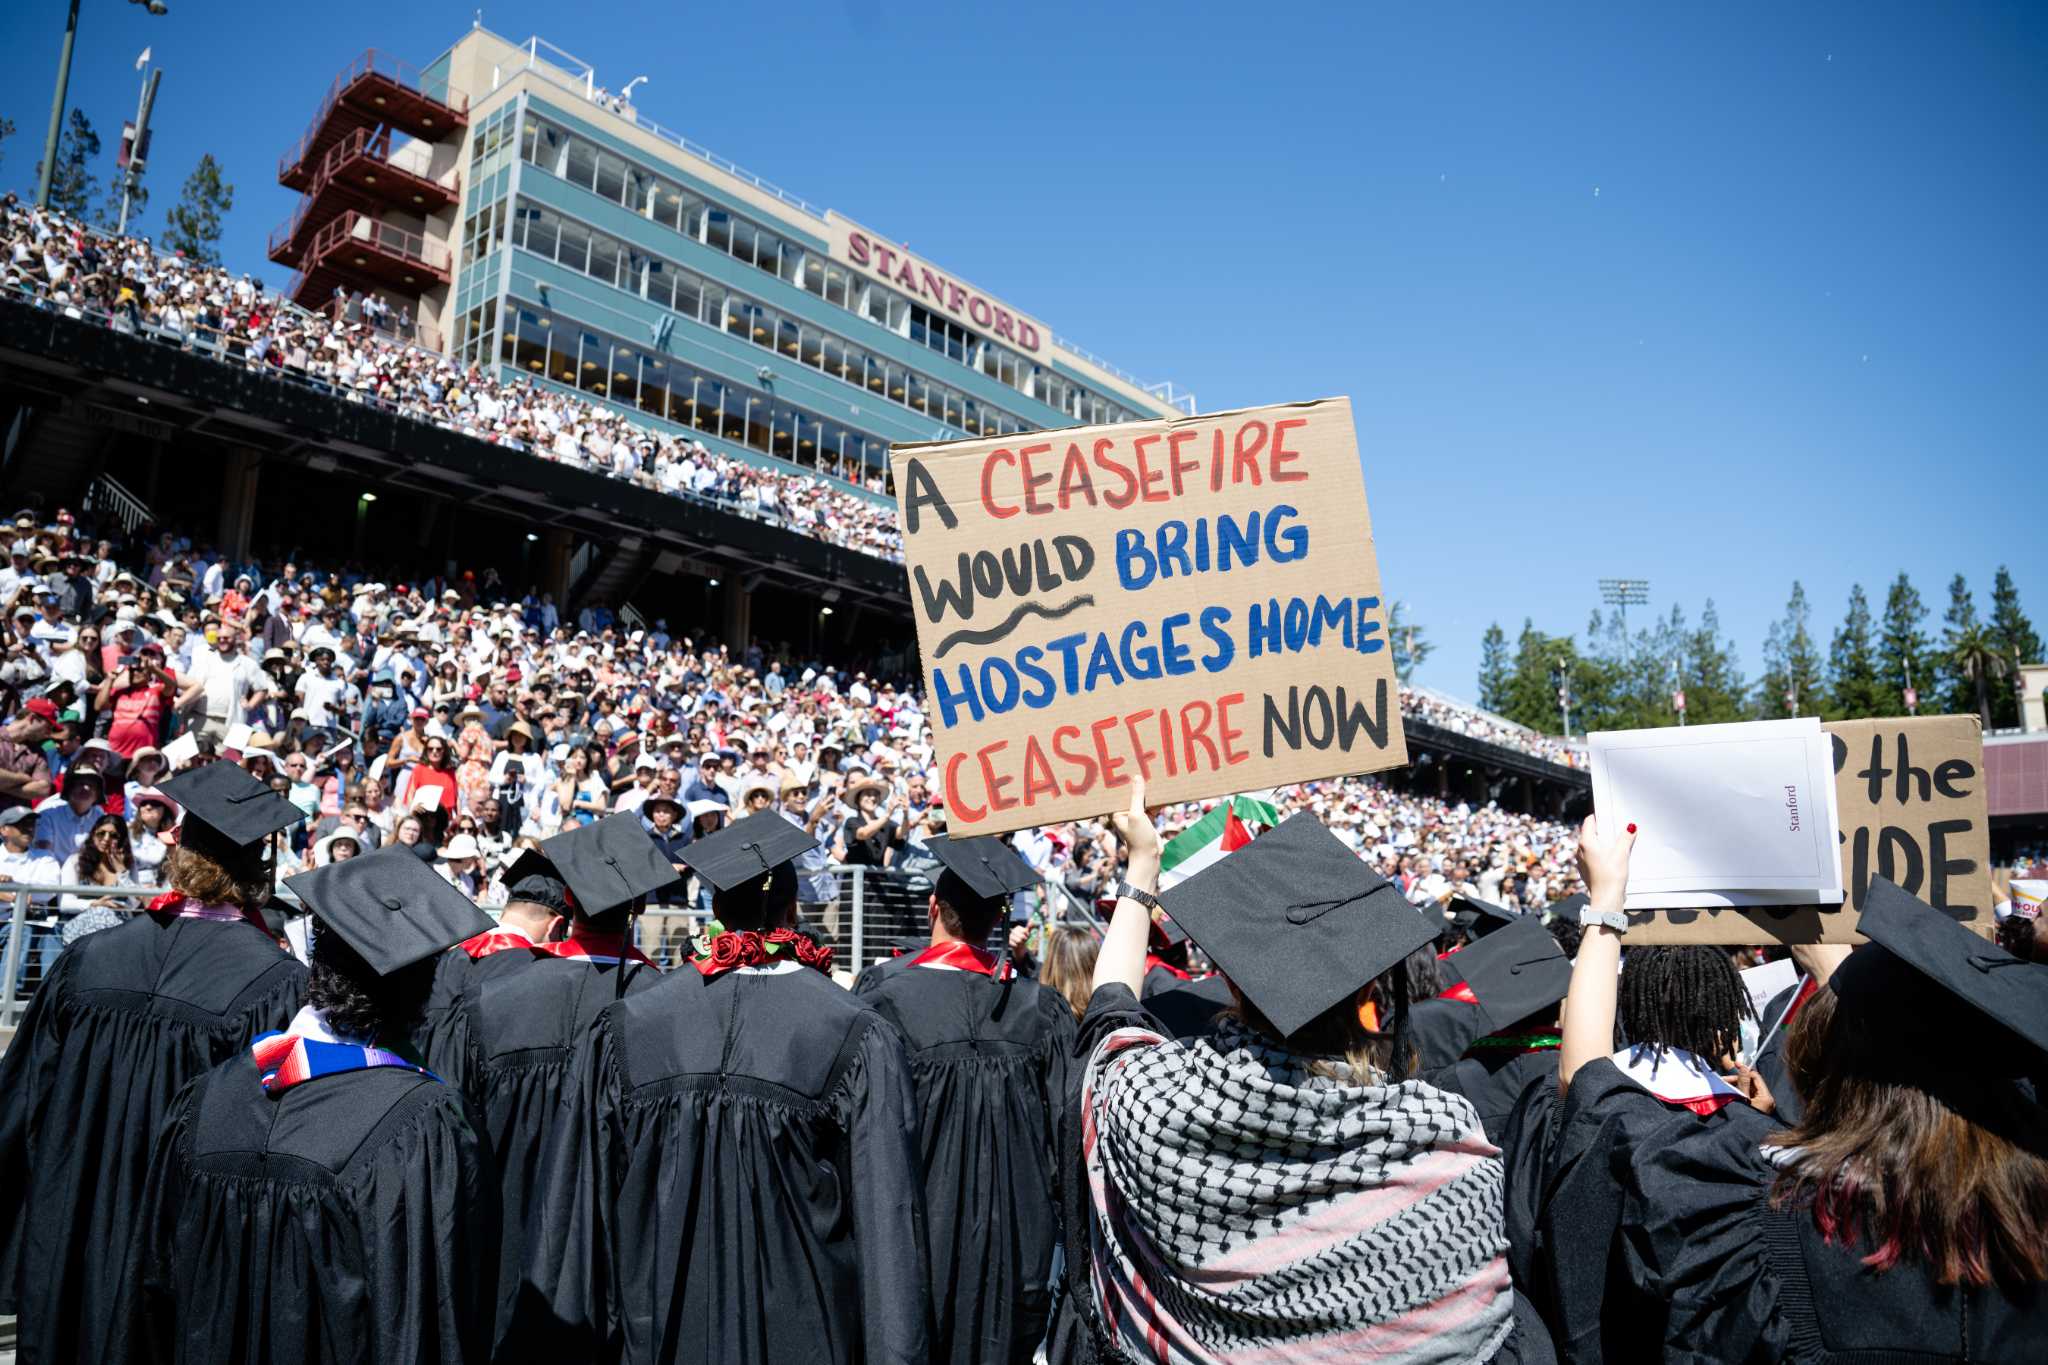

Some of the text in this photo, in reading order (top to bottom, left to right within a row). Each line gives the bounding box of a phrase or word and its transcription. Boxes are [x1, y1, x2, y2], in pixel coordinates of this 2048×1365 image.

[848, 231, 1040, 352] STANFORD
[906, 418, 1309, 534] A CEASEFIRE
[913, 504, 1309, 623] WOULD BRING
[932, 594, 1385, 729] HOSTAGES HOME
[945, 678, 1389, 823] CEASEFIRE NOW
[1784, 785, 1801, 832] Stanford
[1857, 732, 1976, 806] the
